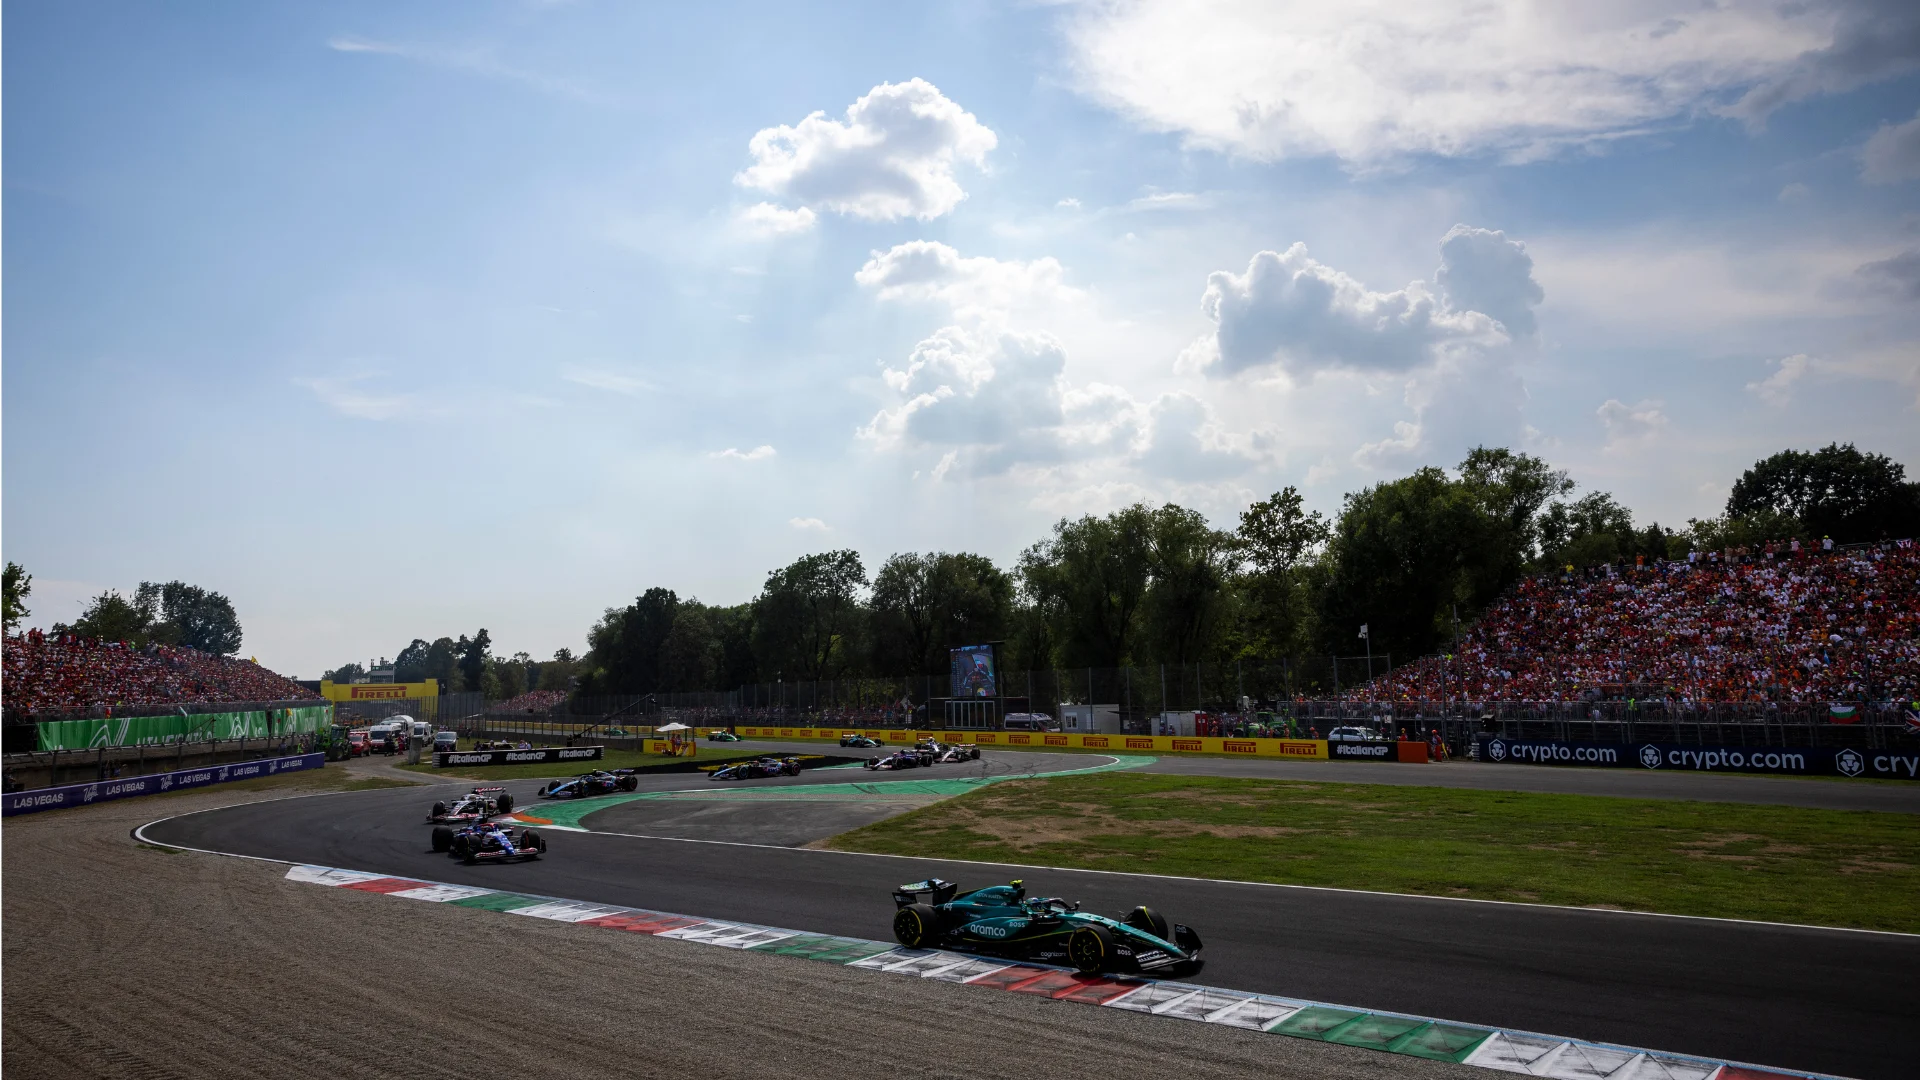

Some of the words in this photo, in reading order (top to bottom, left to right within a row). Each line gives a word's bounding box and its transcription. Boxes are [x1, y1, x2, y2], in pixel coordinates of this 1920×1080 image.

[352, 686, 407, 698] PIRELLI
[945, 733, 963, 742] PIRELLI
[976, 734, 996, 743] PIRELLI
[1008, 734, 1030, 745] PIRELLI
[1044, 735, 1067, 746] PIRELLI
[1083, 736, 1108, 748] PIRELLI
[1126, 738, 1153, 749] PIRELLI
[1172, 739, 1202, 751] PIRELLI
[1223, 740, 1256, 753] PIRELLI
[1279, 742, 1317, 755] PIRELLI
[1511, 743, 1617, 763] crypto.com
[1668, 748, 1805, 770] crypto.com
[233, 767, 243, 777] LAS
[243, 765, 260, 774] VEGAS
[179, 775, 192, 785] LAS
[192, 772, 211, 782] VEGAS
[106, 785, 121, 796] LAS
[121, 781, 145, 793] VEGAS
[13, 796, 33, 809] LAS
[33, 793, 64, 806] VEGAS
[970, 924, 1006, 937] aramco
[1117, 948, 1132, 956] BOSS
